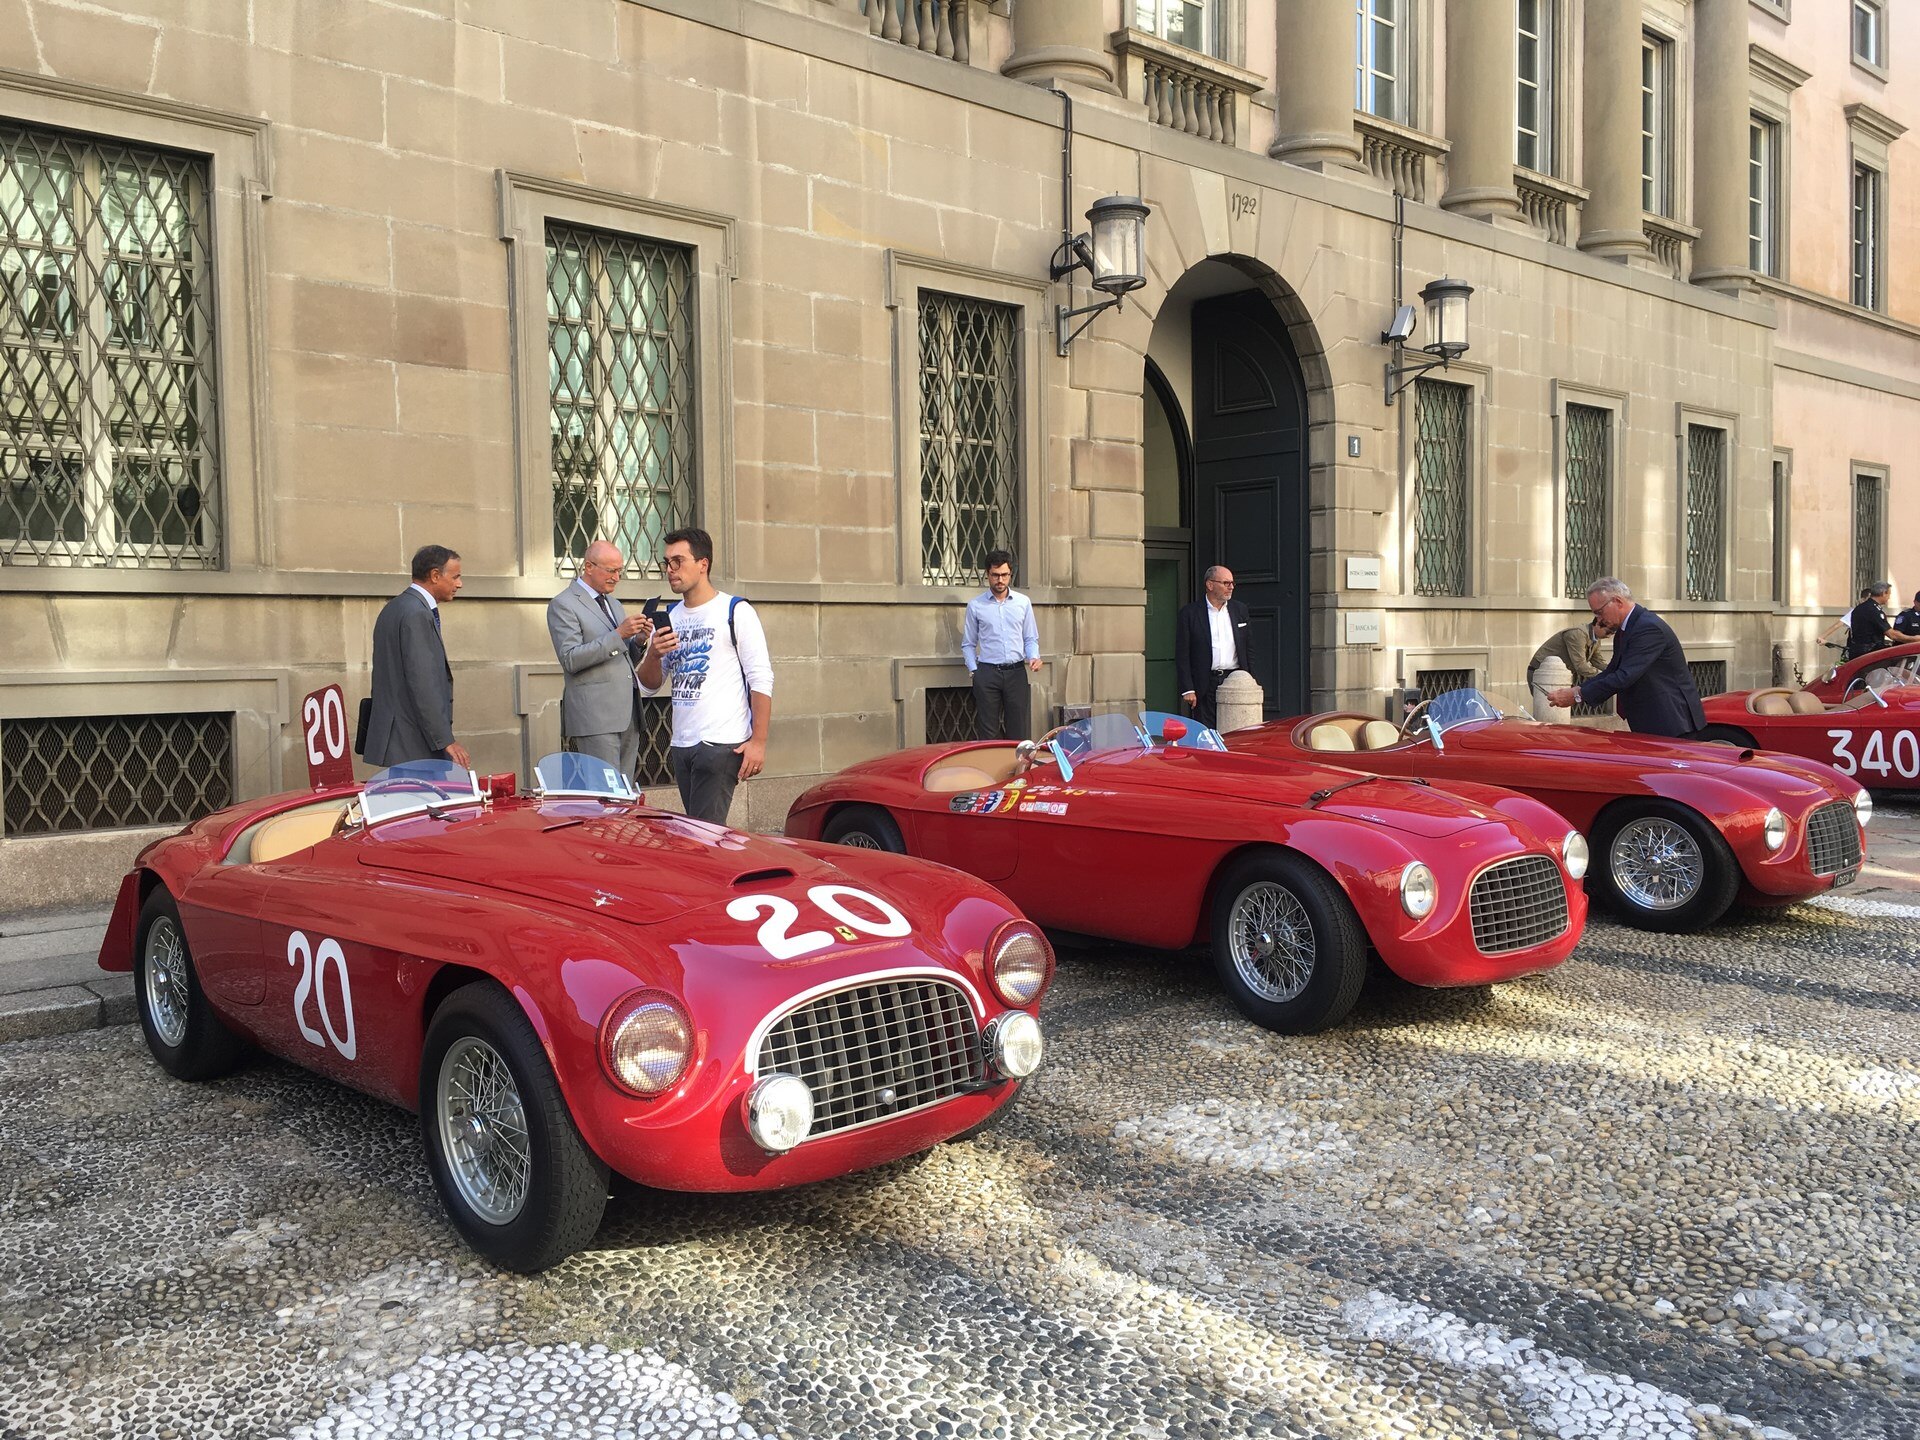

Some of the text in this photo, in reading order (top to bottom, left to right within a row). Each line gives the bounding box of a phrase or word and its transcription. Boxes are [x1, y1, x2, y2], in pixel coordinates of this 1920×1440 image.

[1231, 192, 1257, 222] 1722
[1352, 438, 1359, 455] 1
[304, 688, 345, 766] 20
[1827, 729, 1920, 779] 340
[725, 884, 912, 960] 20
[287, 930, 357, 1061] 20
